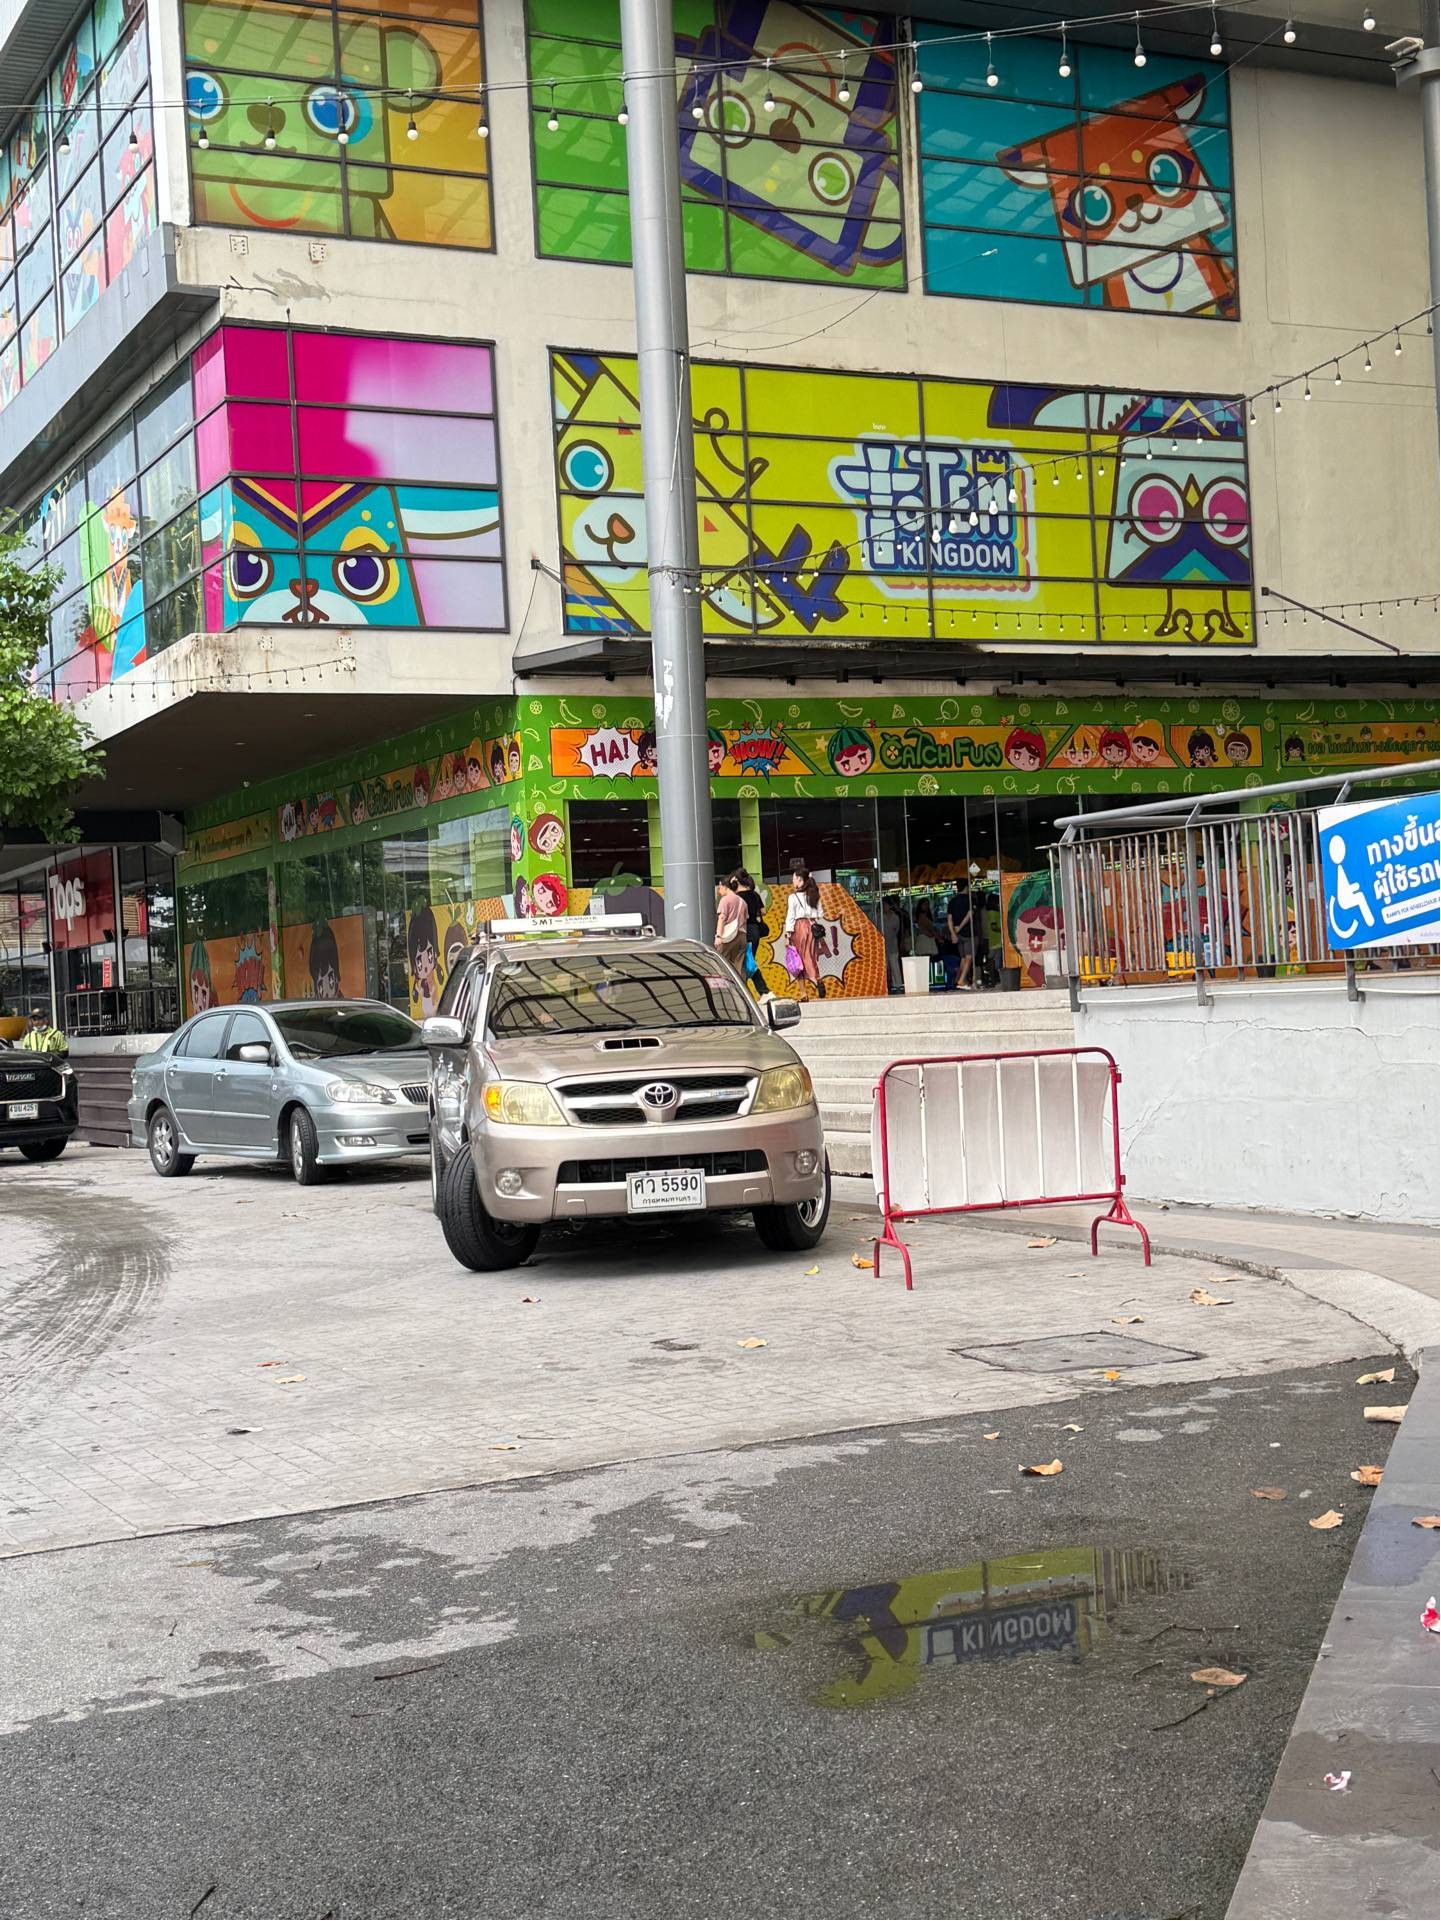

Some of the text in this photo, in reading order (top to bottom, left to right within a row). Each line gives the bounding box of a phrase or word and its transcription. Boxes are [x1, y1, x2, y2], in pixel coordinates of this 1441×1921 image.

[902, 541, 1012, 569] KINGDOM
[590, 737, 630, 767] HA!
[729, 738, 786, 765] WOW!
[49, 874, 86, 931] Tops
[661, 1176, 699, 1192] 5590
